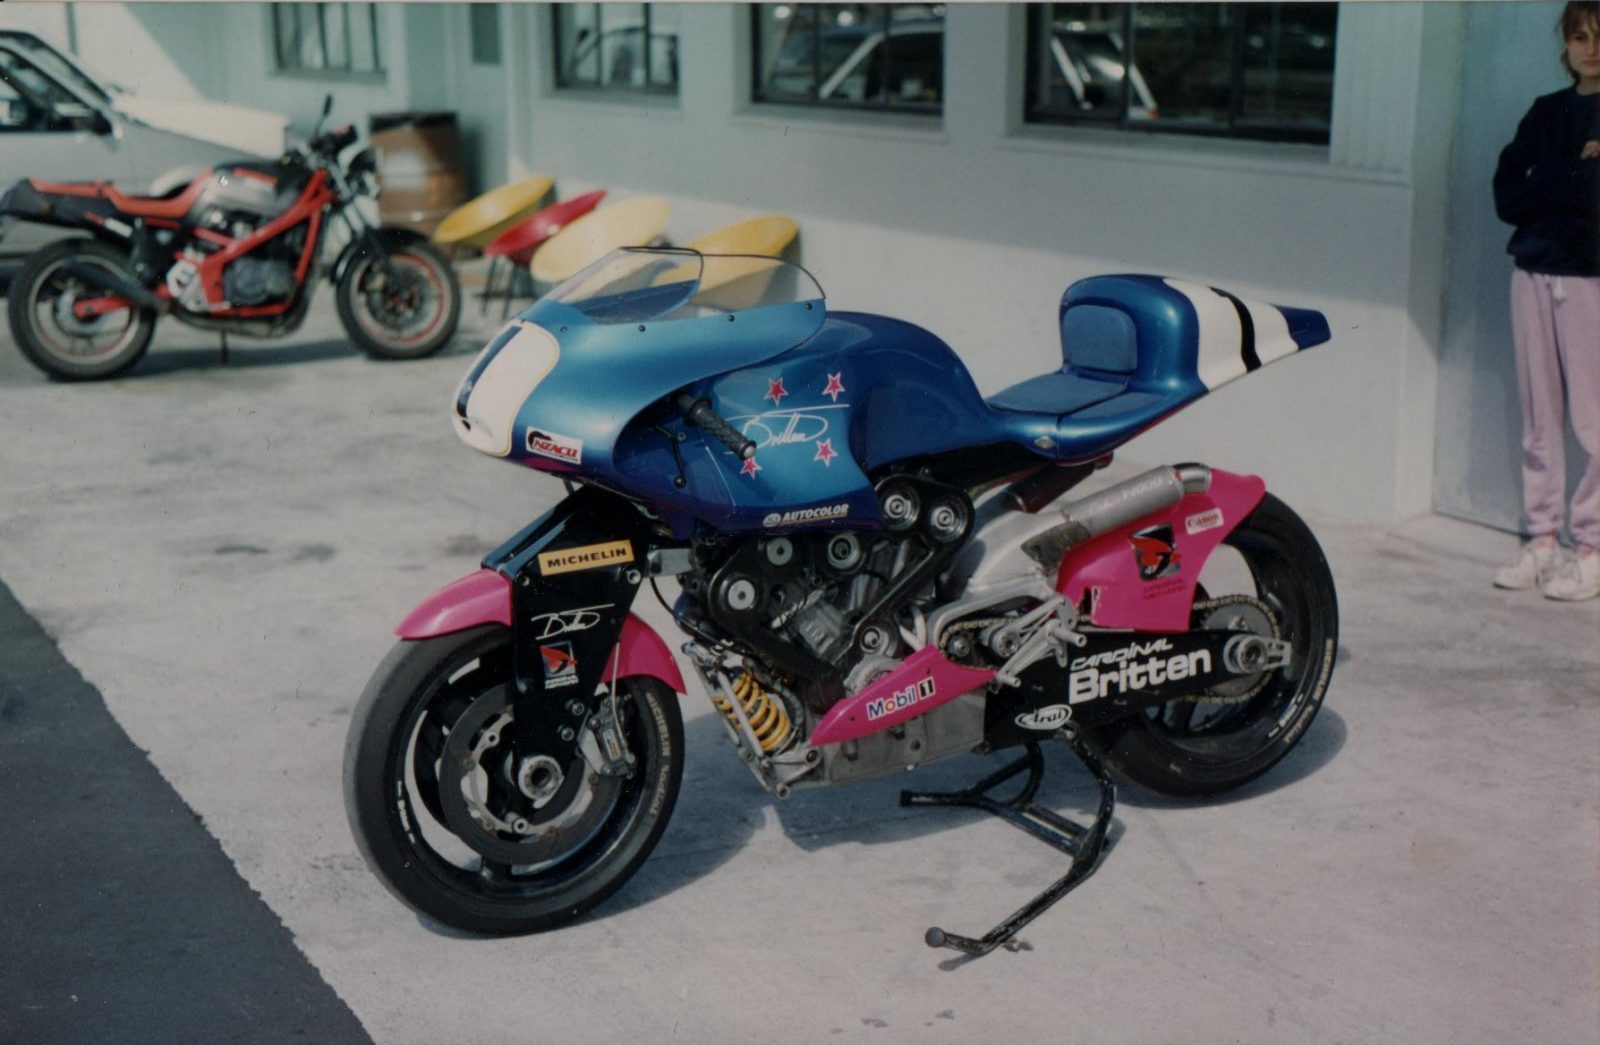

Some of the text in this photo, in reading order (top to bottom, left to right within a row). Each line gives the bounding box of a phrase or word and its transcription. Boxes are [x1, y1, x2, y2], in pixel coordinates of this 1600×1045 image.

[782, 503, 849, 523] AUTOCOLOR
[546, 547, 628, 569] MICHELIN
[1070, 637, 1174, 672] CARDINAL
[1068, 648, 1212, 704] Britten
[867, 677, 936, 719] Mobil 1
